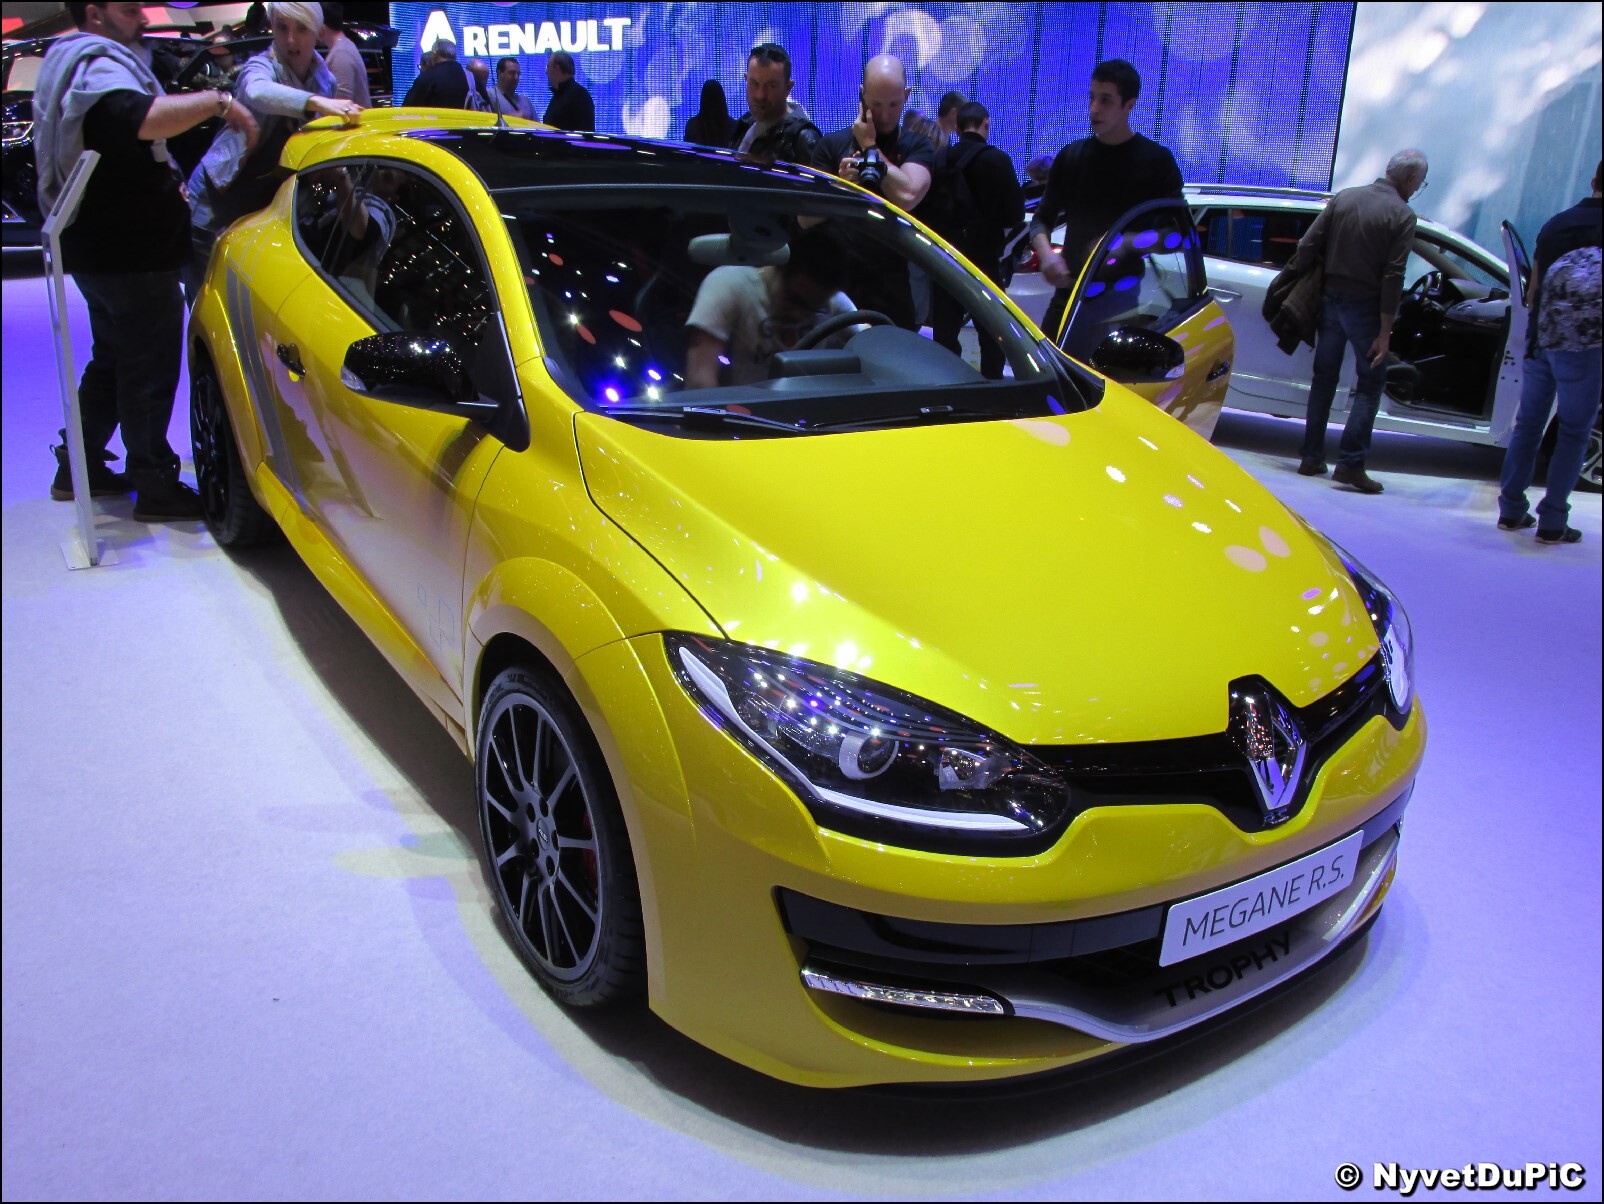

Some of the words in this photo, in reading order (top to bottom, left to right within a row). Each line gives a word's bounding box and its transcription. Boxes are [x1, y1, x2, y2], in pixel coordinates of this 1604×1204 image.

[463, 17, 632, 56] RENAULT
[1182, 873, 1305, 947] MEGANE
[1307, 854, 1345, 896] R.S.
[1154, 930, 1292, 1009] TROPHY
